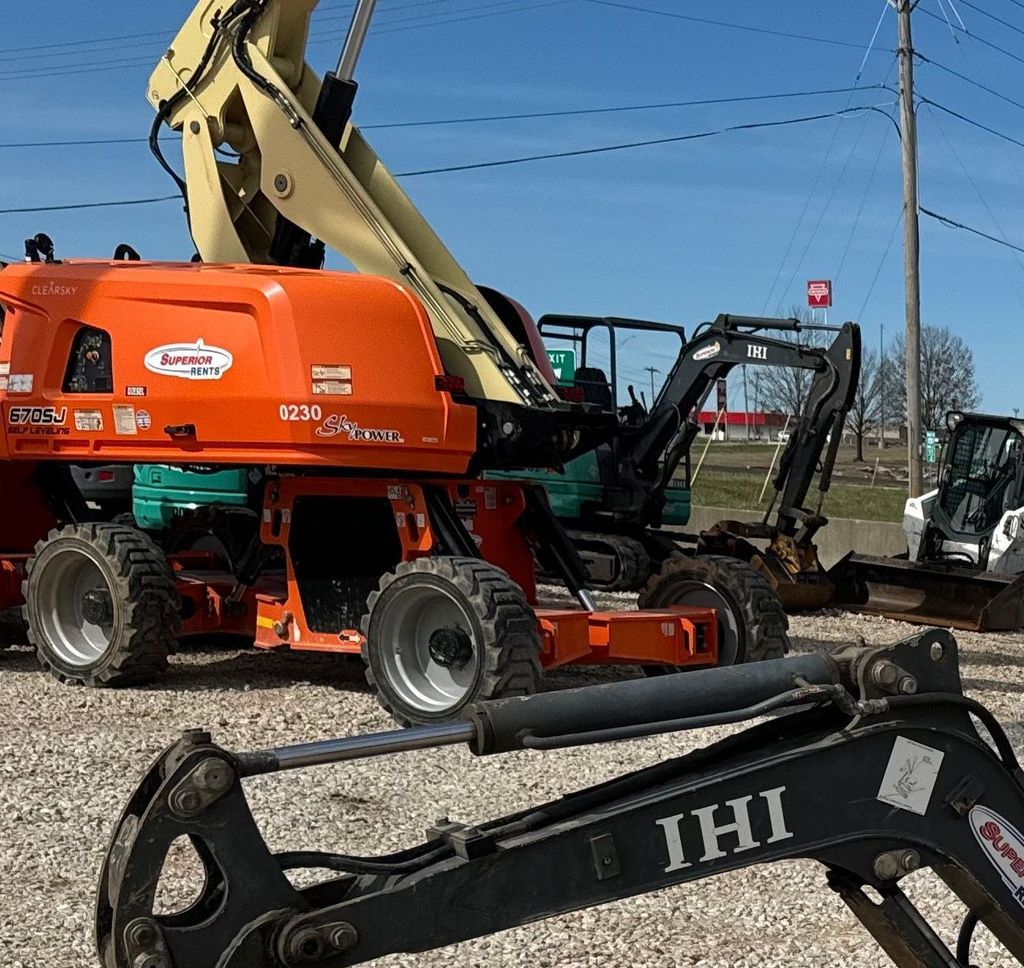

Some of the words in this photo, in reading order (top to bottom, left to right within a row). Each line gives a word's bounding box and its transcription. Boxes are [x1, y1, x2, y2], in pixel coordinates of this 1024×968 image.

[32, 281, 78, 295] CLEARSKY
[549, 353, 567, 364] XIT
[747, 344, 768, 359] IHI
[160, 353, 213, 366] SUPERIOR
[190, 366, 220, 375] RENTS
[9, 406, 68, 425] 670SJ
[279, 404, 322, 421] 0230
[655, 785, 794, 873] IHI
